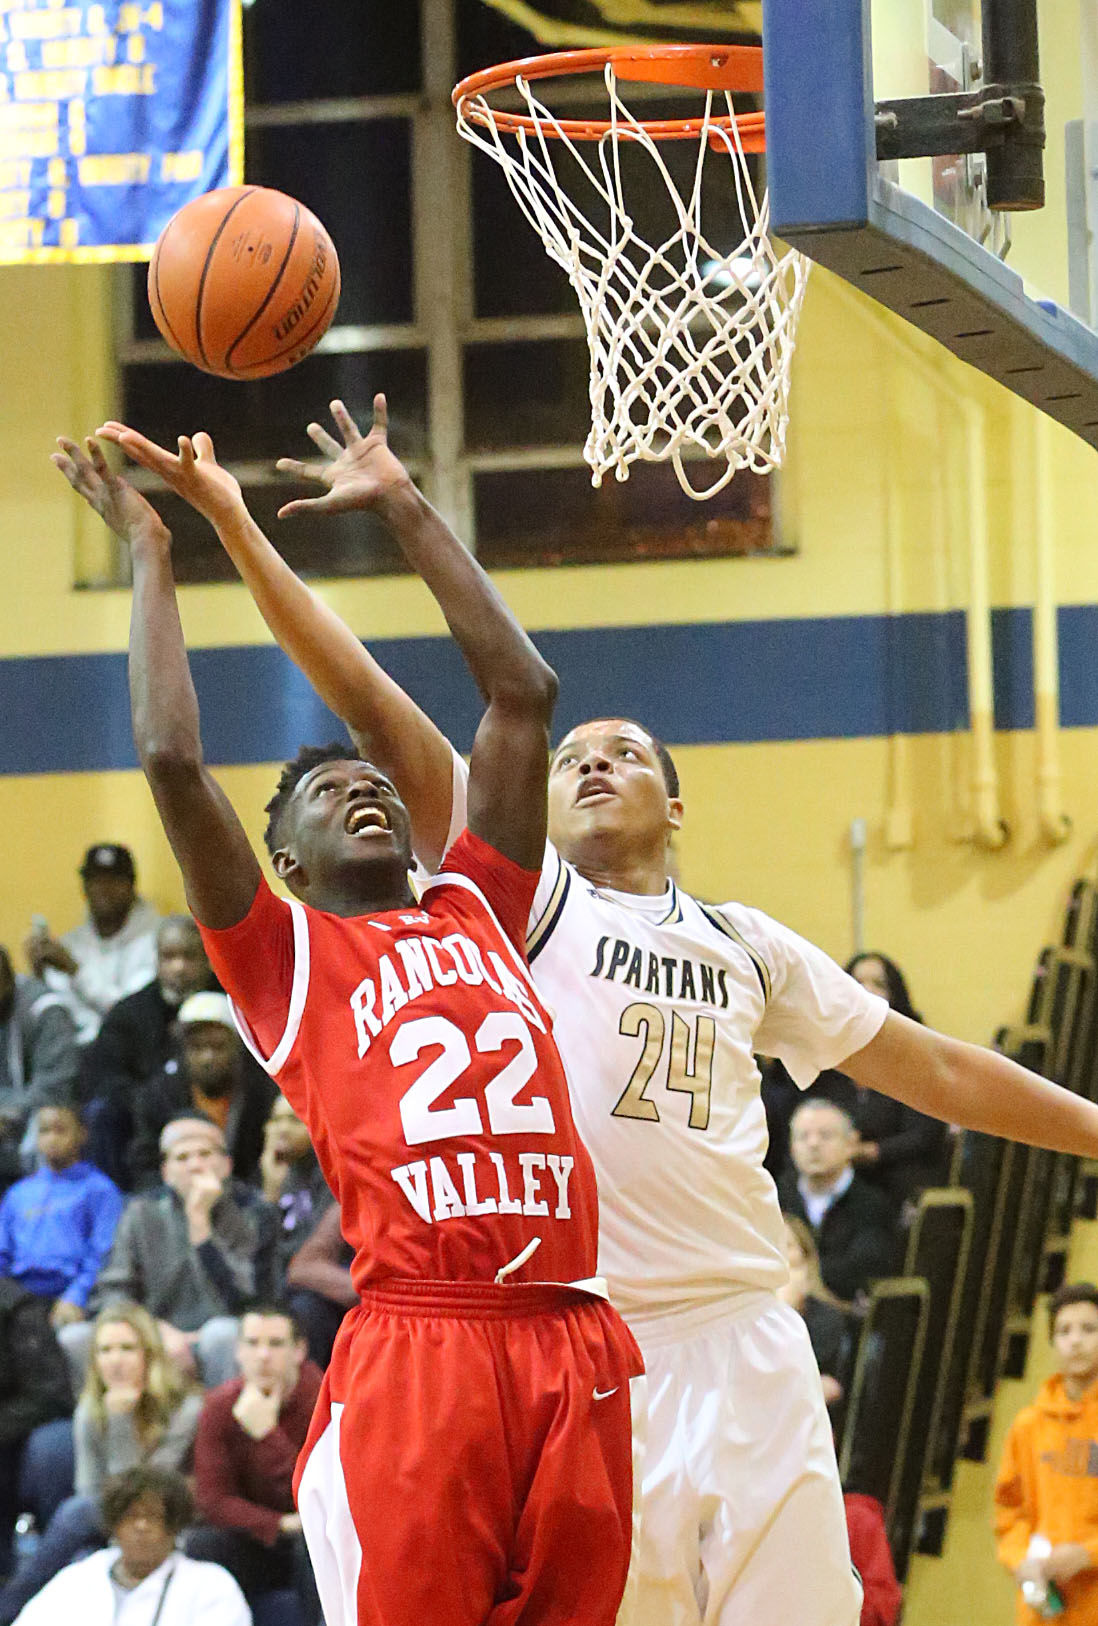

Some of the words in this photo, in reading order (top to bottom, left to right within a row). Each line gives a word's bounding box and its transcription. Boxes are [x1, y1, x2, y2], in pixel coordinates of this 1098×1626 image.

[589, 935, 729, 1009] SPARTANS
[388, 1011, 556, 1146] 22
[610, 1002, 716, 1131] 24
[390, 1152, 574, 1225] VALLEY
